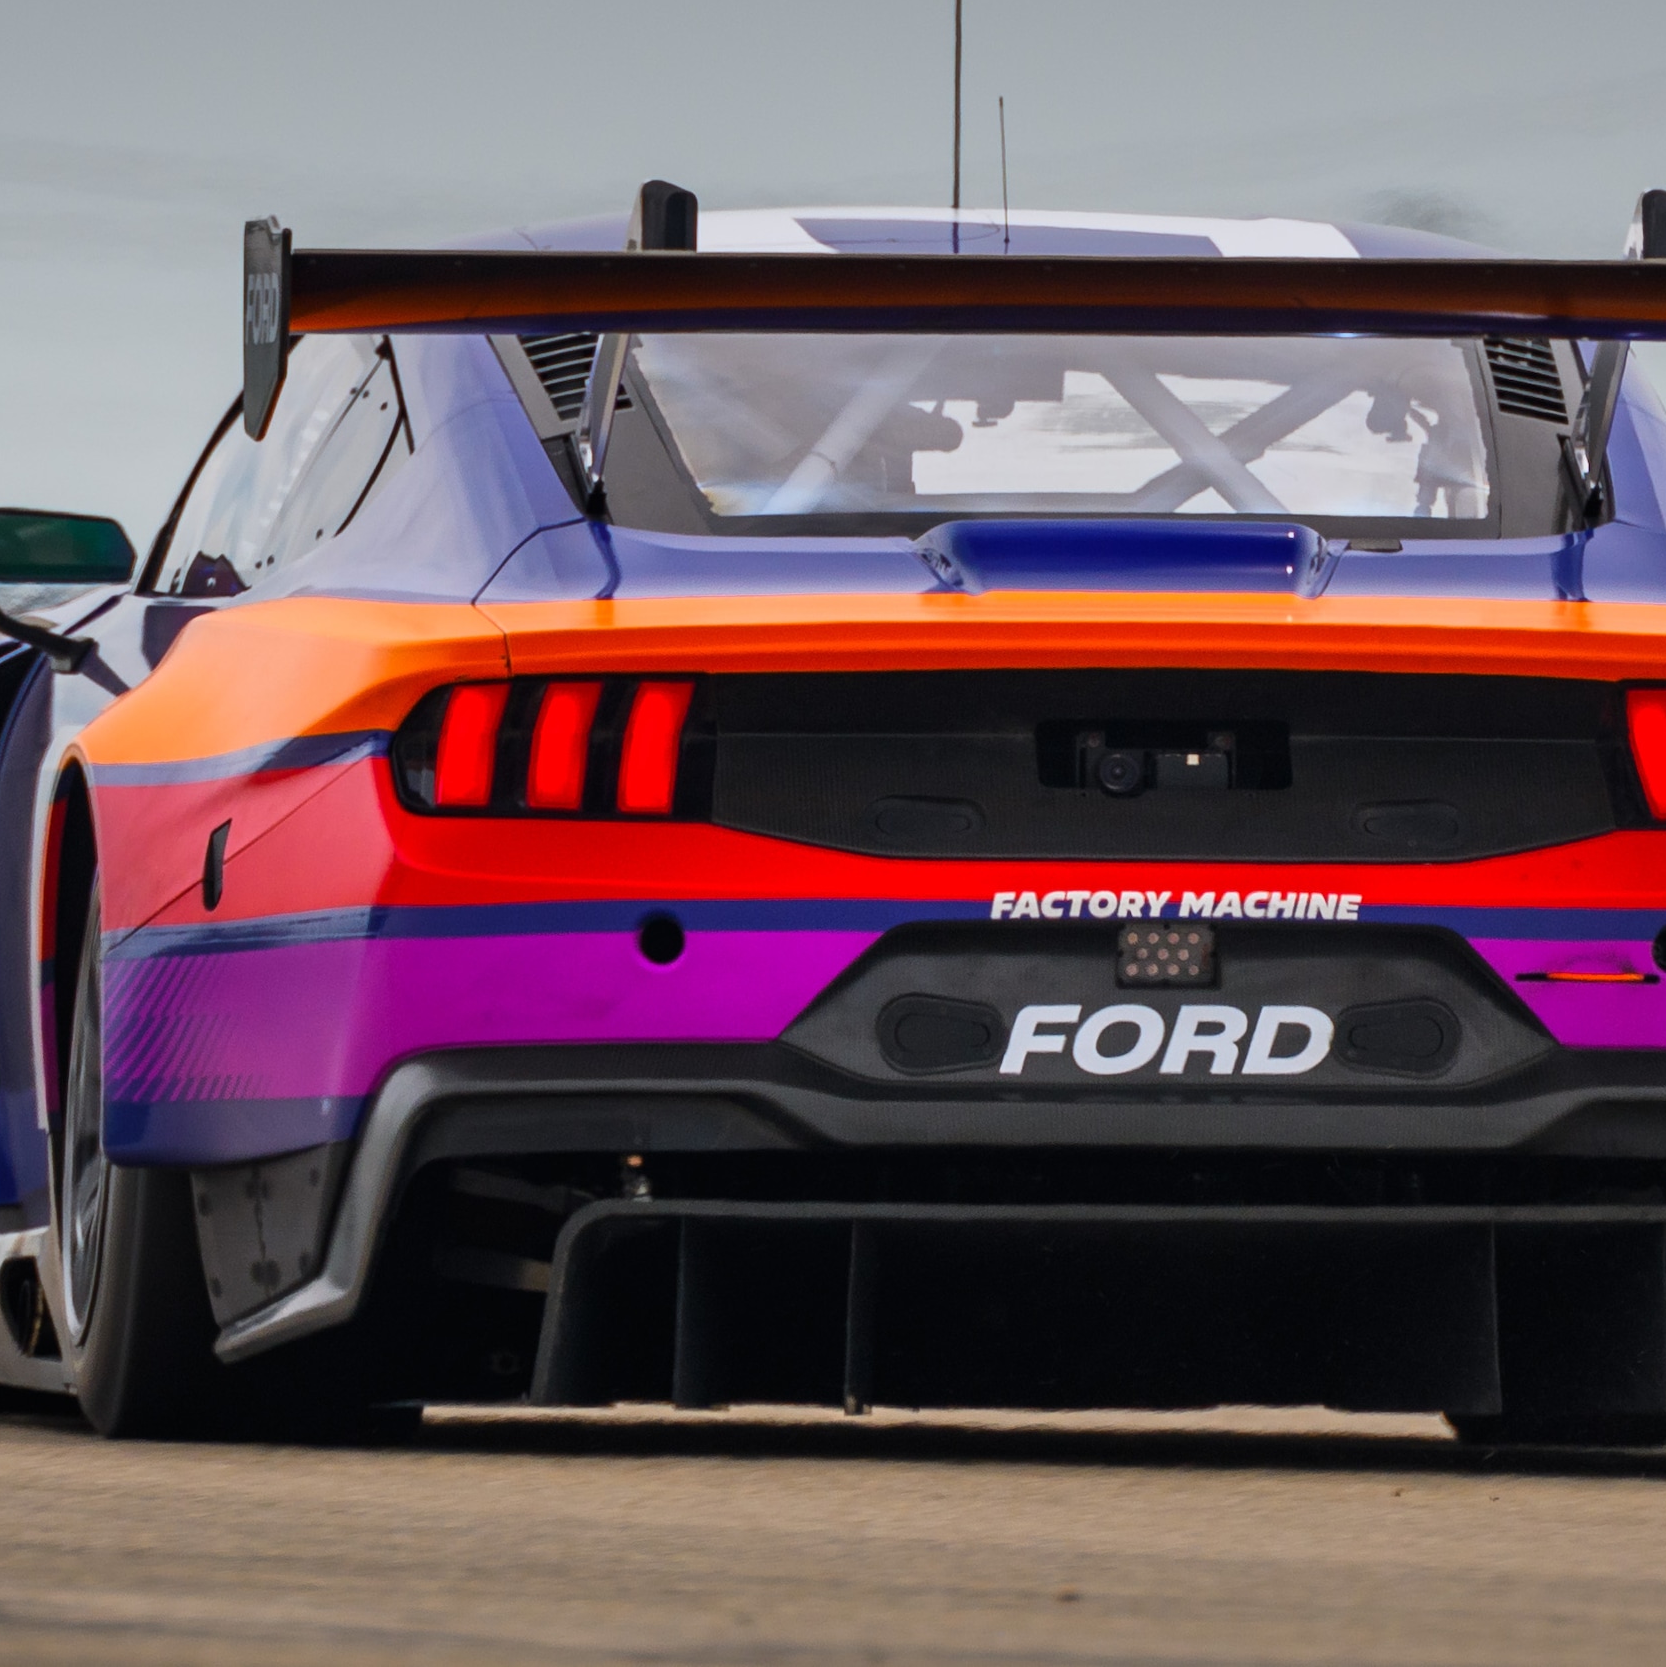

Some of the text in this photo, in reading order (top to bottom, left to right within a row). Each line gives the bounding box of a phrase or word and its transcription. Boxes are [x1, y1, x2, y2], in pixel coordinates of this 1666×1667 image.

[245, 272, 280, 344] FORD
[991, 890, 1362, 921] FACTORY MACHINE
[999, 1004, 1334, 1075] FORD
